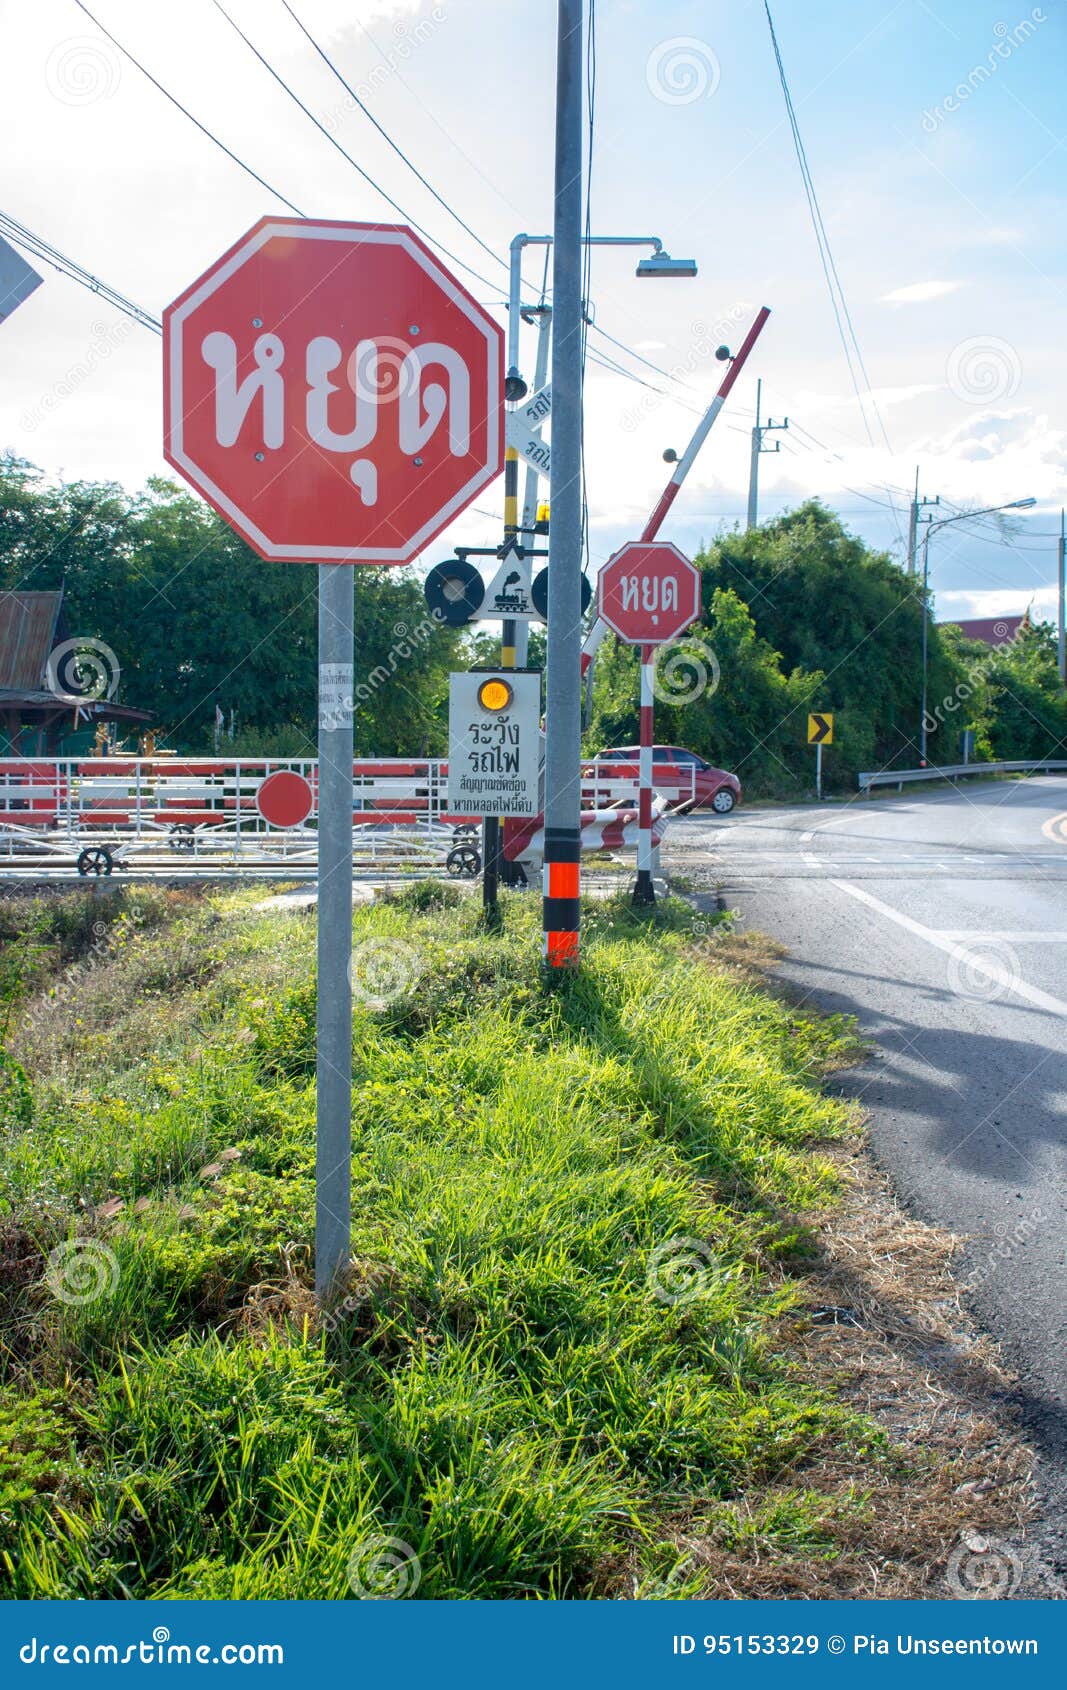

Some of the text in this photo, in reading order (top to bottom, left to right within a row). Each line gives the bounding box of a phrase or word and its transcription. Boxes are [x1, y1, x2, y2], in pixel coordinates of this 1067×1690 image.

[201, 331, 470, 507] หยุด
[620, 575, 678, 625] หยุด
[468, 715, 520, 745] ระวัง
[468, 745, 520, 773] รถไฟ
[460, 774, 527, 794] สัญญาณขัดข้อง
[453, 792, 532, 813] หากหลอดไฟนี้ดับ
